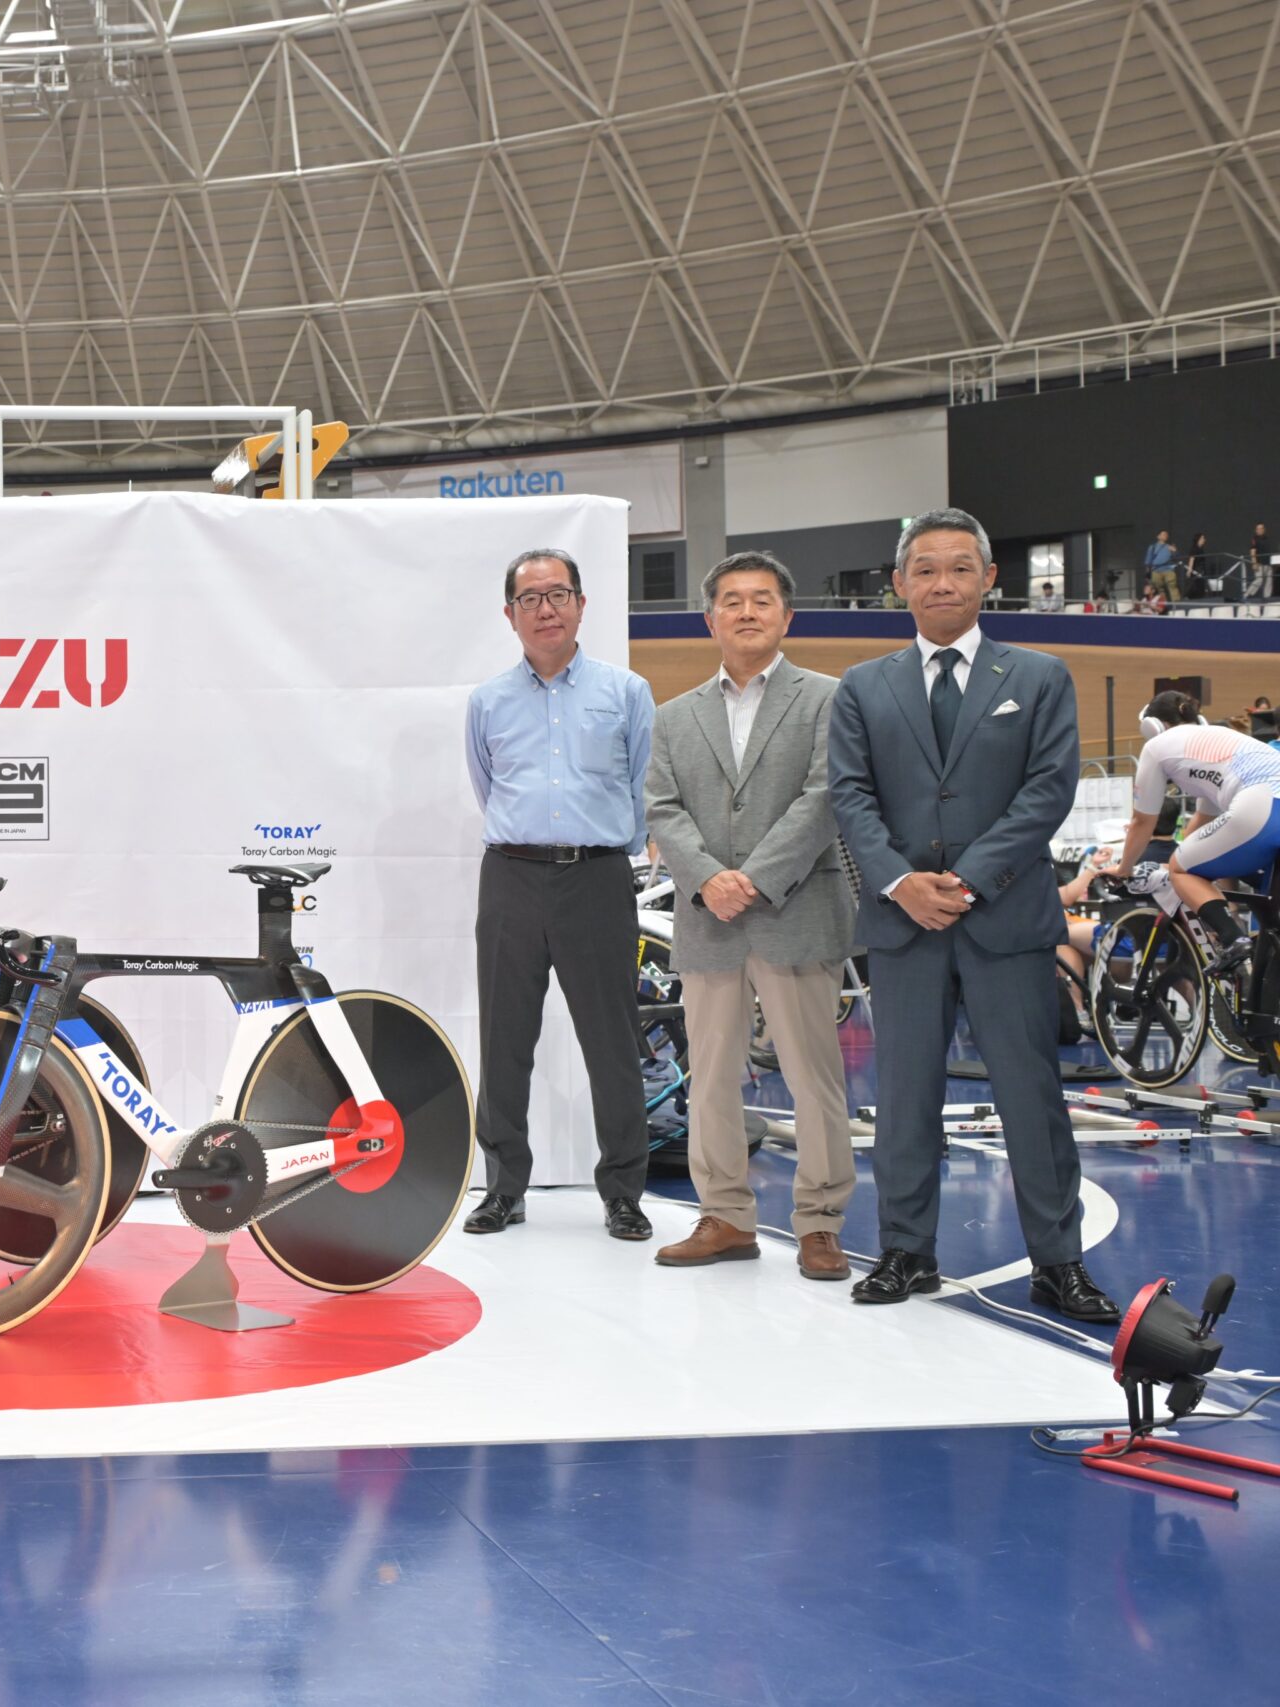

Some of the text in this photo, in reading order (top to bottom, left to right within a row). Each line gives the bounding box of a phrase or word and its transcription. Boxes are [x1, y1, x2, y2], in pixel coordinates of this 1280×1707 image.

[440, 469, 565, 498] Rakuten
[241, 846, 337, 858] Toray Carbon Magic
[123, 959, 199, 972] Toray Carbon Magic
[281, 1151, 330, 1170] JAPAN
